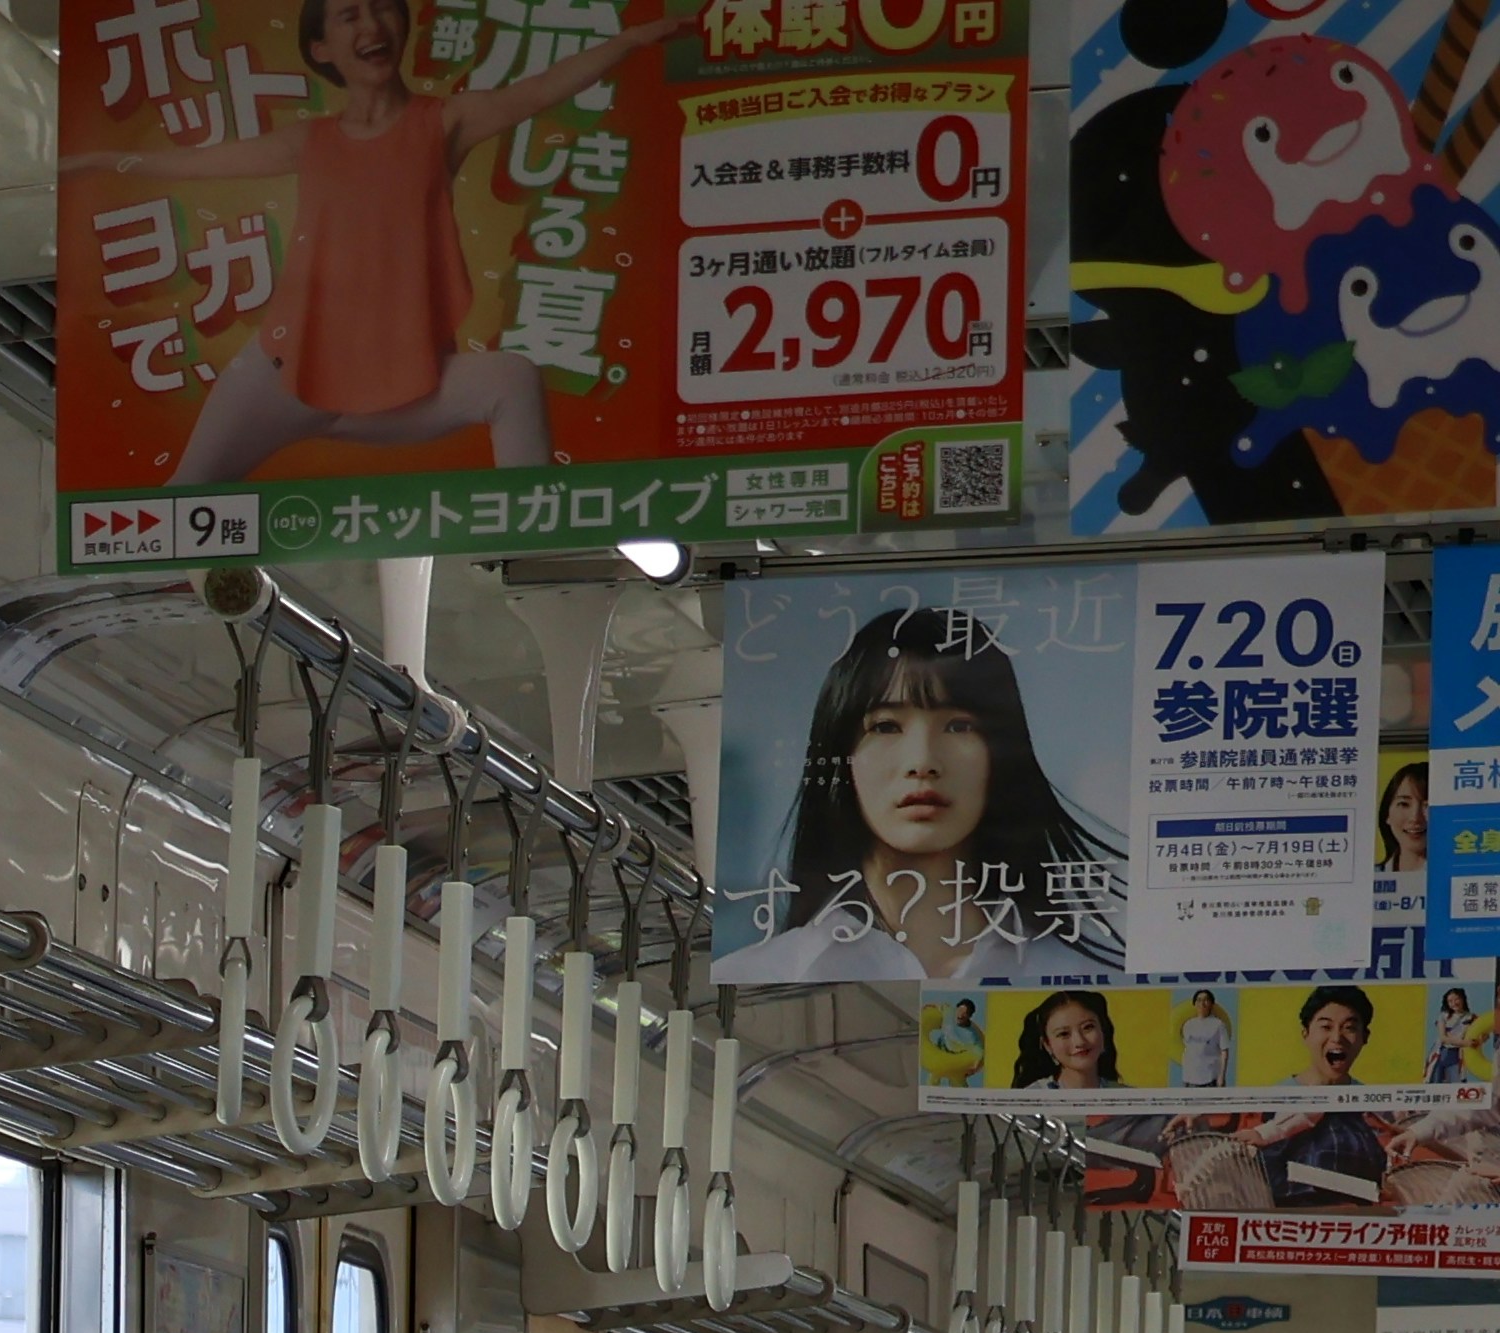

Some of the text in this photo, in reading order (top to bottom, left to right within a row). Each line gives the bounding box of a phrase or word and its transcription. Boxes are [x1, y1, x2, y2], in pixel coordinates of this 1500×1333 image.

[697, 82, 996, 125] 体験当日ご入会でお得なプラン
[690, 271, 993, 376] 月額 2,970円
[745, 469, 830, 489] 女性専用
[880, 455, 898, 510] こちら
[902, 442, 924, 518] ご予約は
[189, 506, 248, 547] 9階
[330, 472, 719, 545] ホットヨガロイブ
[1155, 598, 1334, 670] 7.20
[1153, 678, 1360, 743] 参院選
[1179, 747, 1359, 770] 参議院議員通常選挙
[723, 857, 1121, 948] する?投票
[1196, 1235, 1230, 1247] FLAG
[1203, 1247, 1220, 1259] 6F
[1241, 1218, 1450, 1246] 代ゼミサテライン予備校
